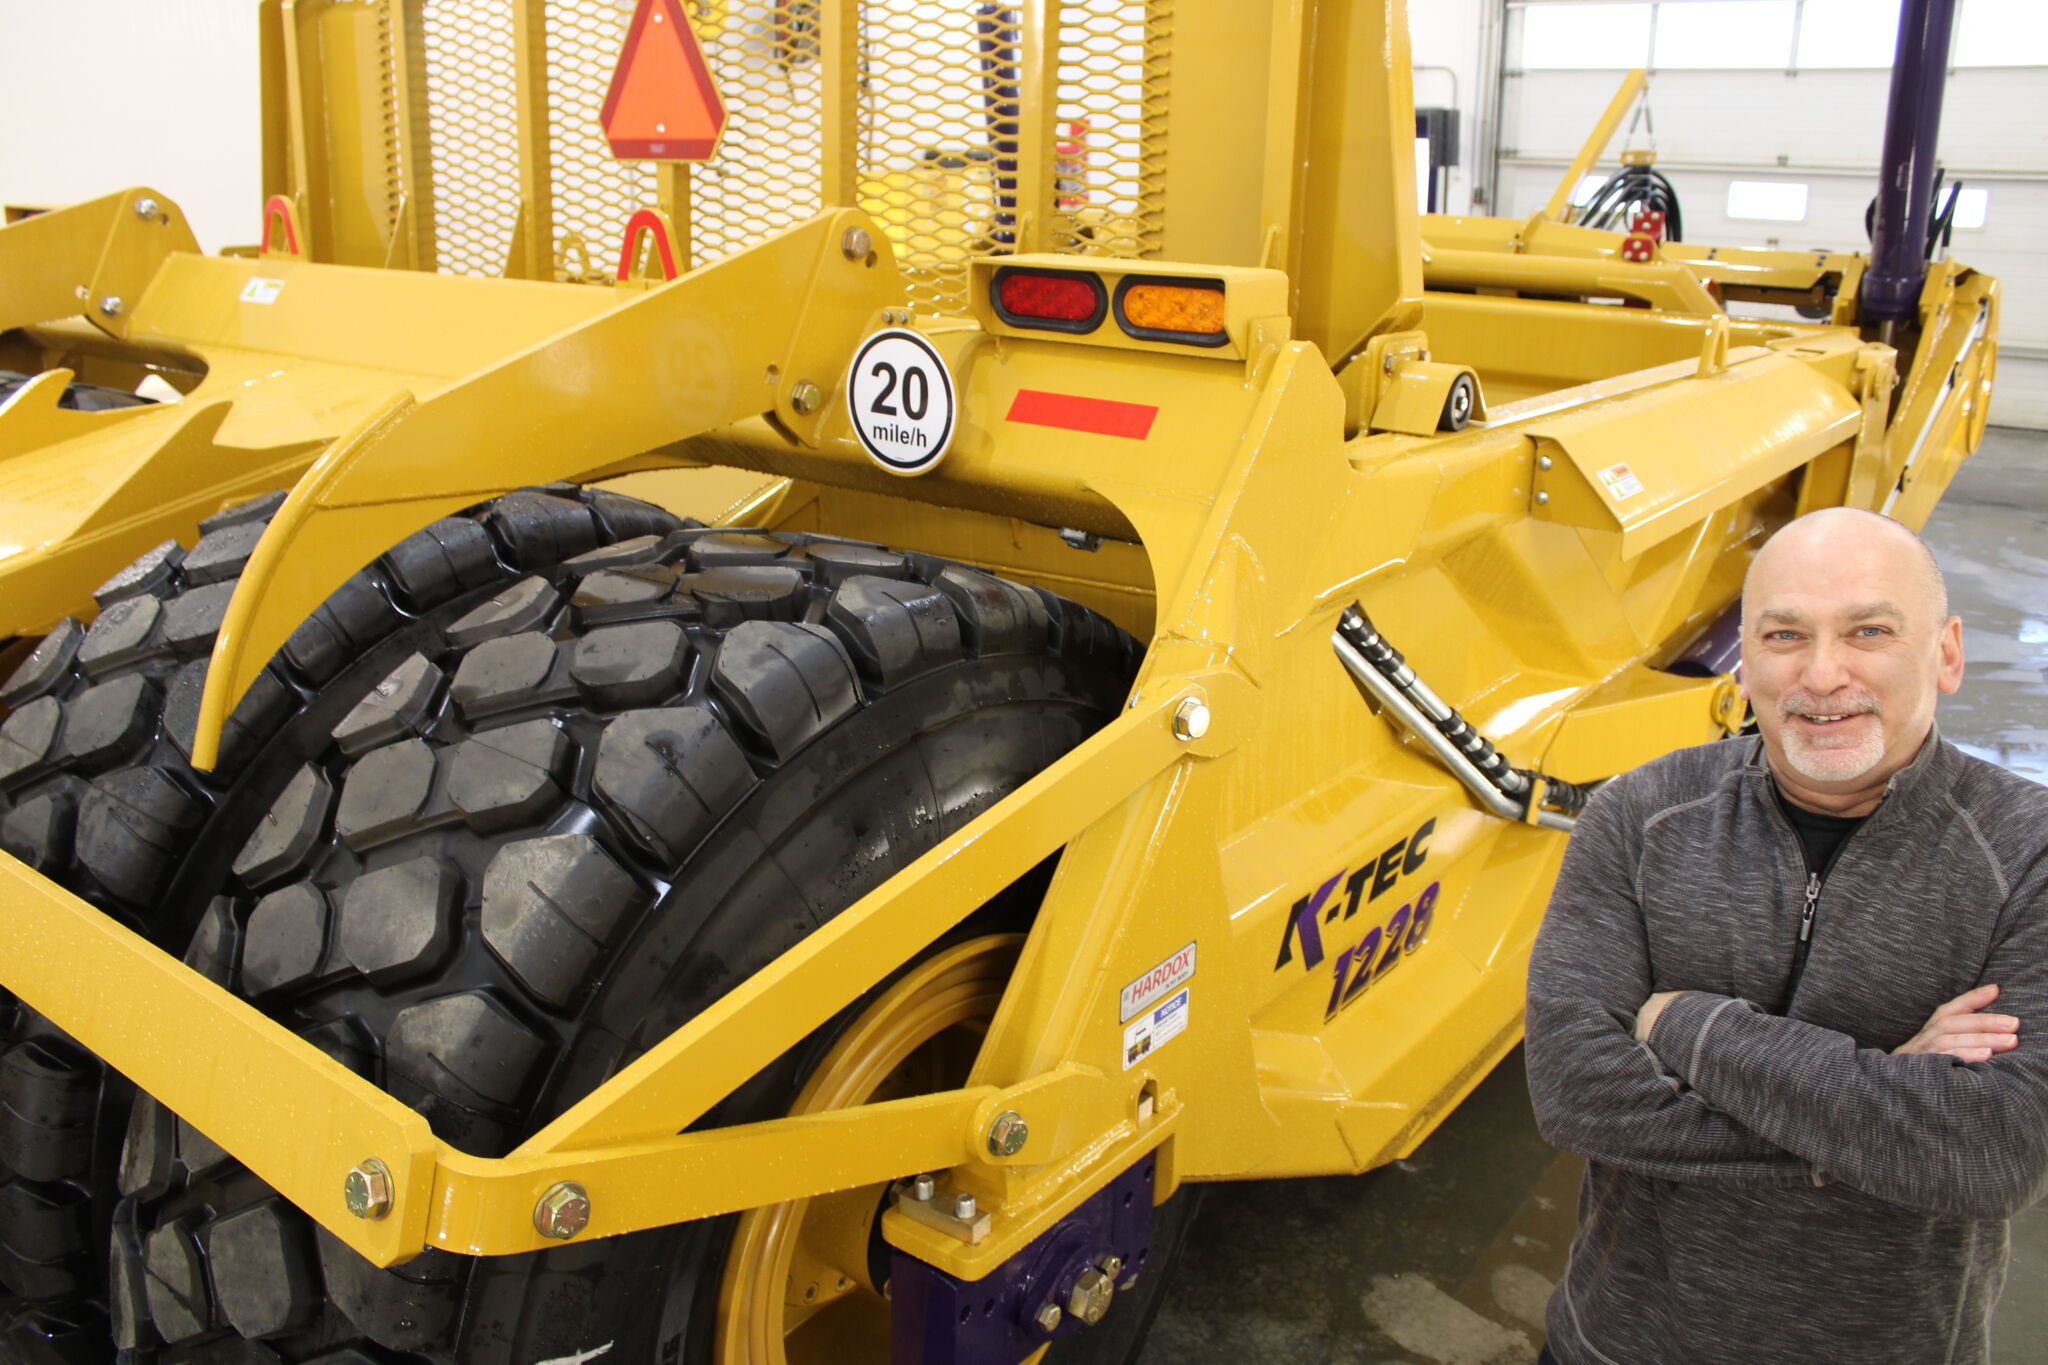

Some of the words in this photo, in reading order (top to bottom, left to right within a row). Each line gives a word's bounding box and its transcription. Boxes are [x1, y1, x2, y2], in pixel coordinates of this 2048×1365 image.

[870, 361, 929, 421] 20
[873, 424, 927, 448] mile/h
[1274, 816, 1437, 972] K-TEC
[1131, 949, 1191, 1004] HARDOX
[1323, 881, 1440, 1025] 1228
